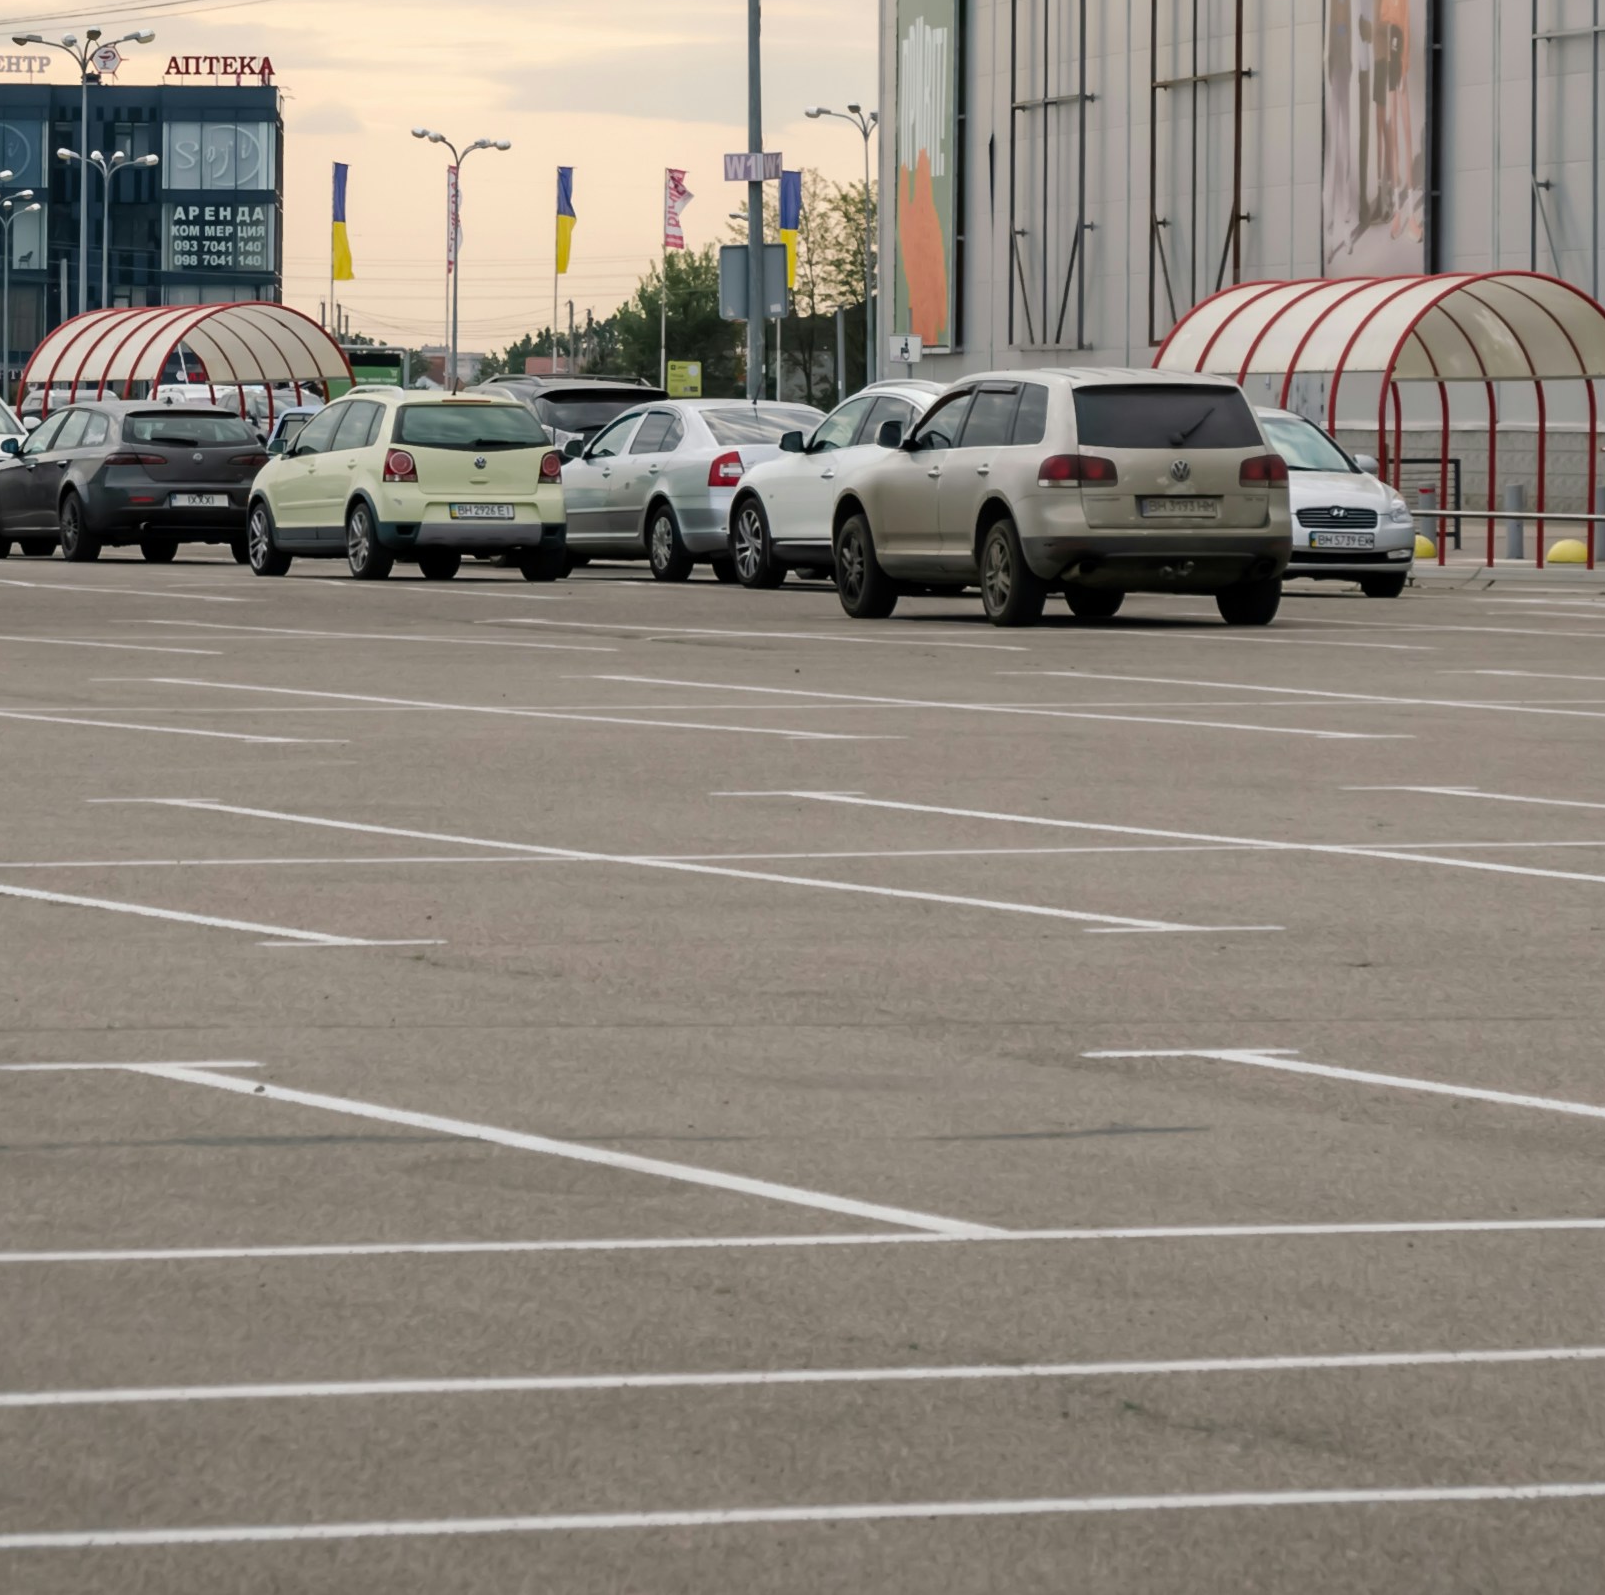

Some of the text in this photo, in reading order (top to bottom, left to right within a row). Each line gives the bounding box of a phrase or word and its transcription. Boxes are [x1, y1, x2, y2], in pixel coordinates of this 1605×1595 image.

[164, 56, 275, 76] АПТЕКА
[726, 155, 756, 179] W1
[174, 206, 264, 222] АРЕНДА
[174, 240, 261, 252] 093 7041 140
[174, 254, 261, 266] 098 7041 140
